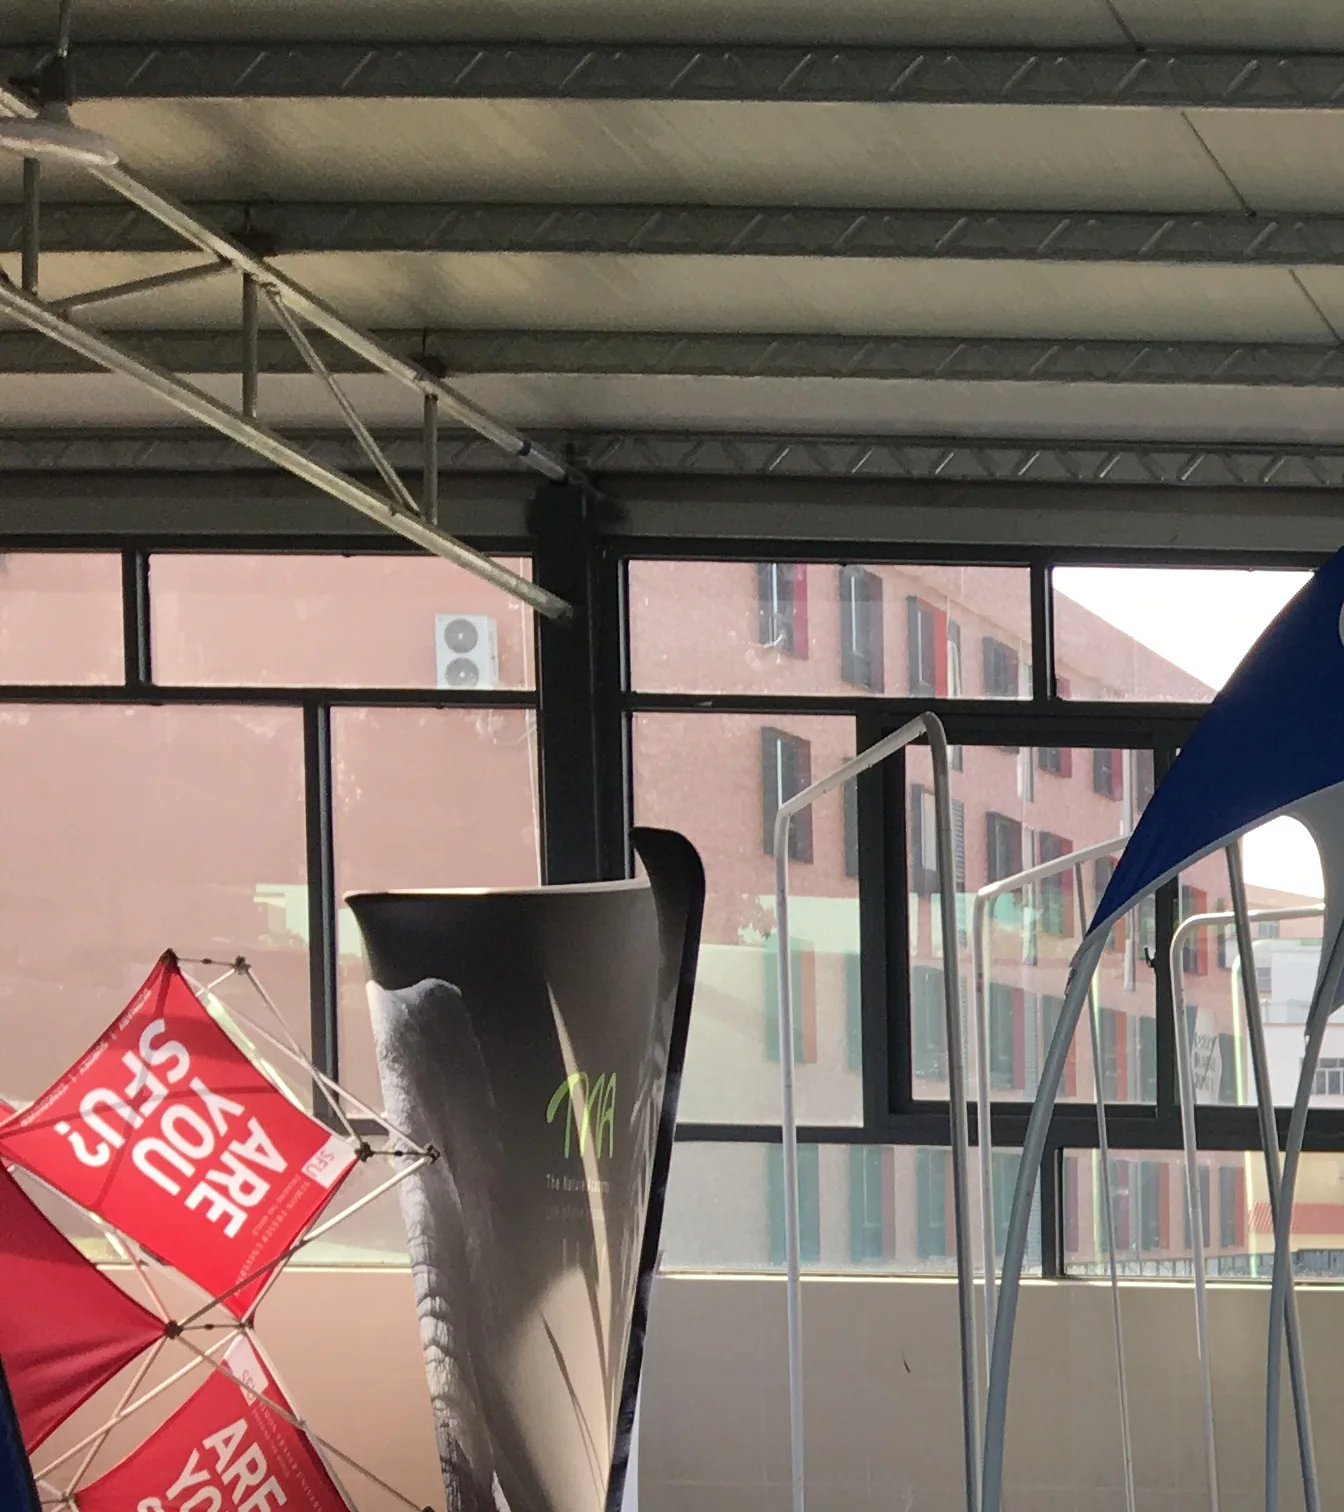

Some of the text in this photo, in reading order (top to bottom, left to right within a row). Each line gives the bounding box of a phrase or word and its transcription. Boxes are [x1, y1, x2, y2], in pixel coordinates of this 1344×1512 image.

[53, 1018, 190, 1168] SFU?
[131, 1076, 245, 1196] YOU
[184, 1116, 288, 1239] ARE
